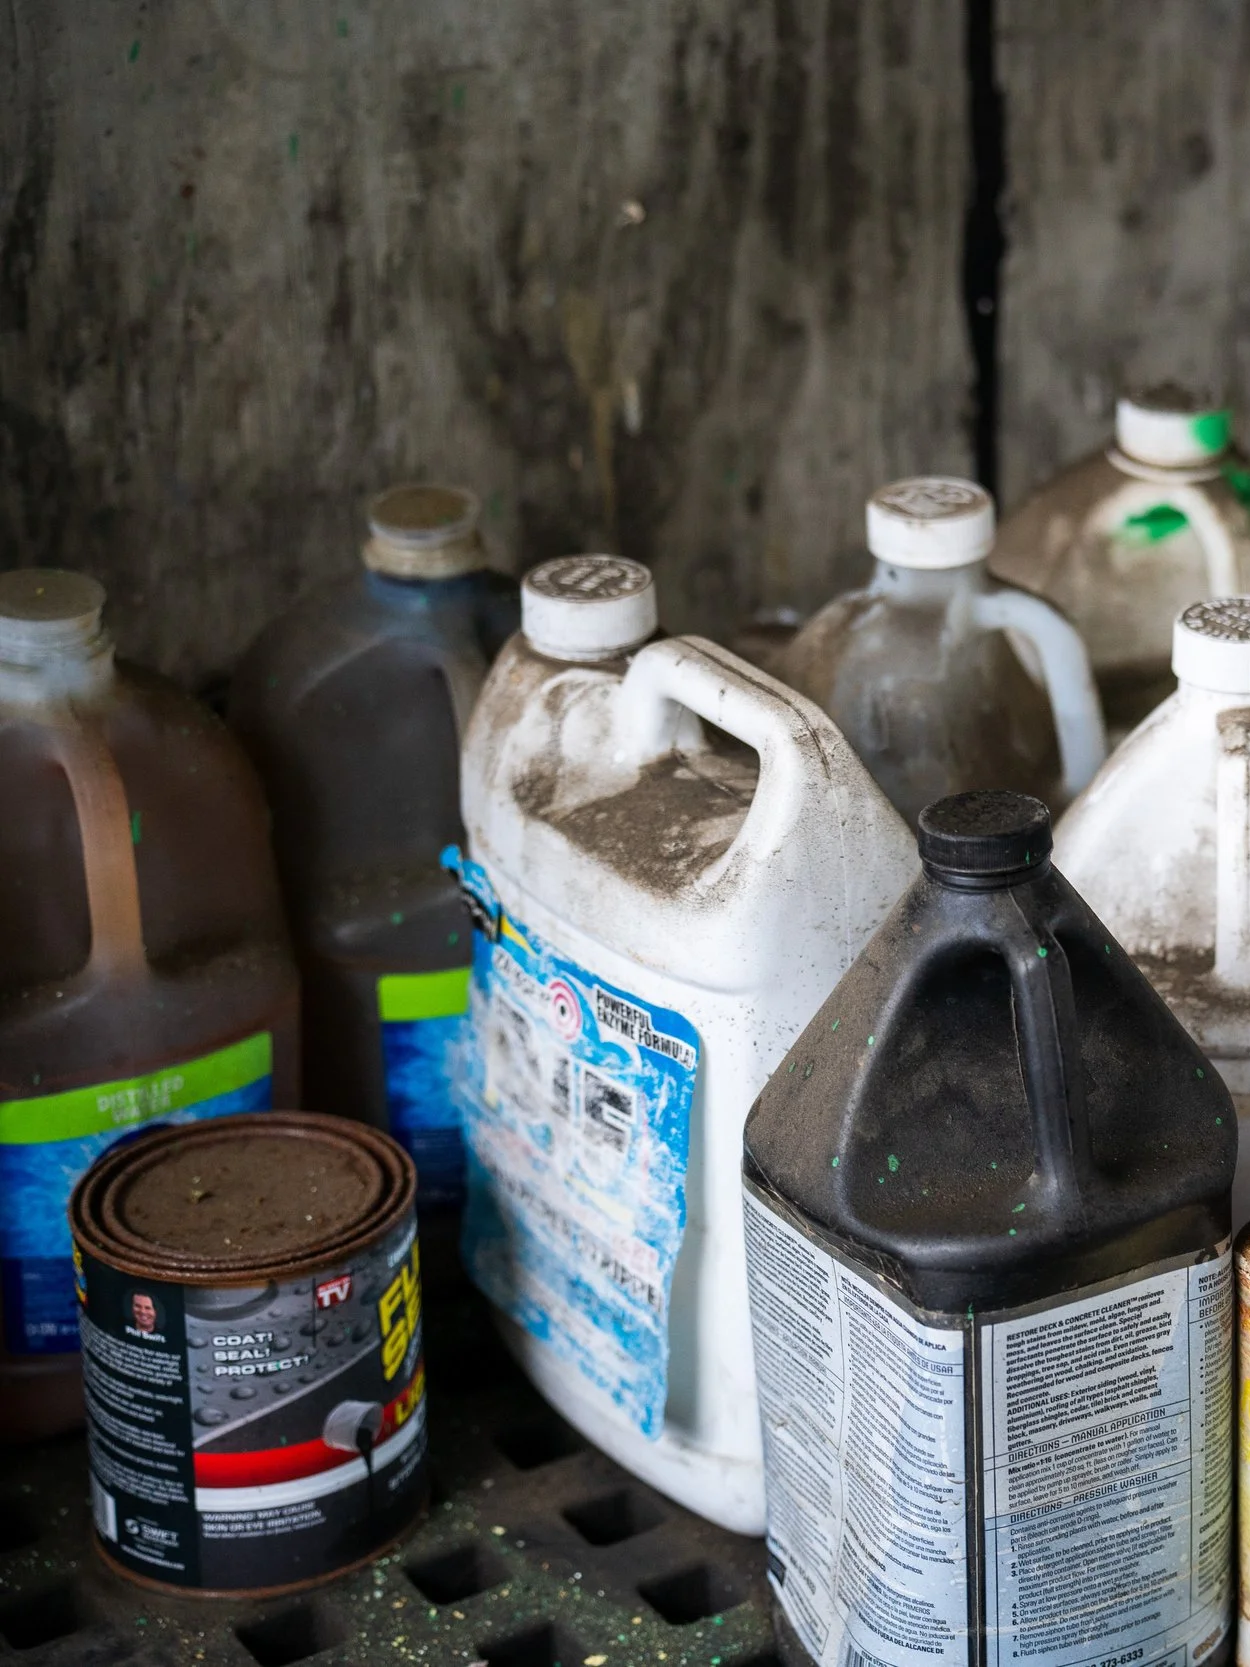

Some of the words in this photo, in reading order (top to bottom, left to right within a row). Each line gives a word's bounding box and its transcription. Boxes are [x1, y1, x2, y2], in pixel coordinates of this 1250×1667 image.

[596, 988, 651, 1031] POWERFUL
[597, 1006, 636, 1040] ENZYME
[318, 1282, 349, 1308] TV
[212, 1332, 273, 1347] COAT!
[1006, 1339, 1025, 1351] tough
[1026, 1333, 1045, 1343] stains
[1046, 1328, 1061, 1338] from
[1063, 1320, 1088, 1333] mildew,
[1108, 1309, 1126, 1320] algae,
[1127, 1302, 1147, 1314] fungus
[1149, 1298, 1160, 1307] and
[1006, 1327, 1037, 1342] RESTORE
[1039, 1320, 1058, 1332] DECK
[1064, 1309, 1099, 1324] CONCRETE
[1006, 1349, 1025, 1358] moss,
[1027, 1343, 1038, 1352] and
[1040, 1337, 1060, 1347] leaves
[1062, 1333, 1073, 1341] the
[1074, 1326, 1097, 1337] surface
[1099, 1320, 1117, 1330] clean.
[1118, 1313, 1142, 1325] Special
[1006, 1351, 1043, 1365] surfactants
[1045, 1341, 1075, 1355] penetrate
[1077, 1337, 1086, 1345] the
[1088, 1330, 1111, 1341] surface
[1120, 1322, 1138, 1333] safely
[1141, 1318, 1150, 1326] and
[1152, 1312, 1170, 1323] easily
[213, 1348, 271, 1362] SEAL!
[214, 1355, 310, 1377] PROTECT!
[924, 1340, 947, 1351] APLICA
[1006, 1362, 1033, 1374] dissolve
[1035, 1358, 1045, 1366] the
[1046, 1350, 1074, 1363] toughest
[1076, 1343, 1094, 1354] stains
[1095, 1338, 1109, 1348] from
[1111, 1334, 1123, 1344] dirt,
[1124, 1331, 1134, 1340] oil,
[1135, 1326, 1156, 1337] grease,
[1159, 1320, 1171, 1329] bird
[1006, 1369, 1040, 1383] droppings,
[1041, 1363, 1054, 1372] tree
[1056, 1360, 1069, 1369] sap,
[1070, 1355, 1082, 1364] and
[1113, 1341, 1128, 1351] Even
[1156, 1330, 1170, 1339] gray
[930, 1364, 953, 1374] USAR
[1006, 1376, 1043, 1392] weathering
[1054, 1366, 1073, 1377] wood,
[1075, 1357, 1103, 1371] chalking,
[1105, 1353, 1116, 1361] and
[1007, 1380, 1053, 1398] Recommended
[1055, 1376, 1065, 1384] for
[1066, 1371, 1083, 1381] wood
[1085, 1367, 1096, 1375] and
[1097, 1358, 1129, 1372] composite
[1131, 1351, 1150, 1362] decks,
[1152, 1344, 1173, 1355] fences
[1006, 1399, 1019, 1408] and
[1021, 1390, 1050, 1403] concrete.
[1007, 1399, 1048, 1415] ADDITIONAL
[1050, 1392, 1069, 1403] USES:
[1071, 1384, 1096, 1396] Exterior
[1097, 1378, 1116, 1390] siding
[1117, 1371, 1138, 1384] (wood,
[1140, 1366, 1156, 1377] vinyl,
[1007, 1419, 1039, 1433] fiberglass
[1041, 1409, 1068, 1423] shingles,
[1070, 1403, 1089, 1414] cedar,
[1090, 1399, 1102, 1409] tile)
[1104, 1394, 1120, 1403] brick
[1121, 1390, 1132, 1398] and
[1133, 1383, 1157, 1394] cement
[1046, 1401, 1068, 1413] roofing
[1086, 1390, 1103, 1402] types
[1104, 1383, 1129, 1396] (asphalt
[1130, 1374, 1158, 1388] shingles,
[1007, 1429, 1028, 1441] block,
[1030, 1422, 1056, 1434] masonry,
[1058, 1411, 1092, 1426] driveways,
[1094, 1400, 1128, 1415] walkways,
[1130, 1393, 1148, 1404] walls,
[1150, 1389, 1161, 1398] and
[1008, 1440, 1059, 1461] DIRECTIONS
[1071, 1425, 1108, 1443] MANUAL
[1111, 1408, 1165, 1431] APPLICATION
[1010, 1501, 1061, 1522] DIRECTIONS
[1073, 1484, 1117, 1503] PRESSURE
[1120, 1472, 1157, 1489] WASHER
[905, 1641, 935, 1654] ALCANCE
[935, 1647, 945, 1655] DE
